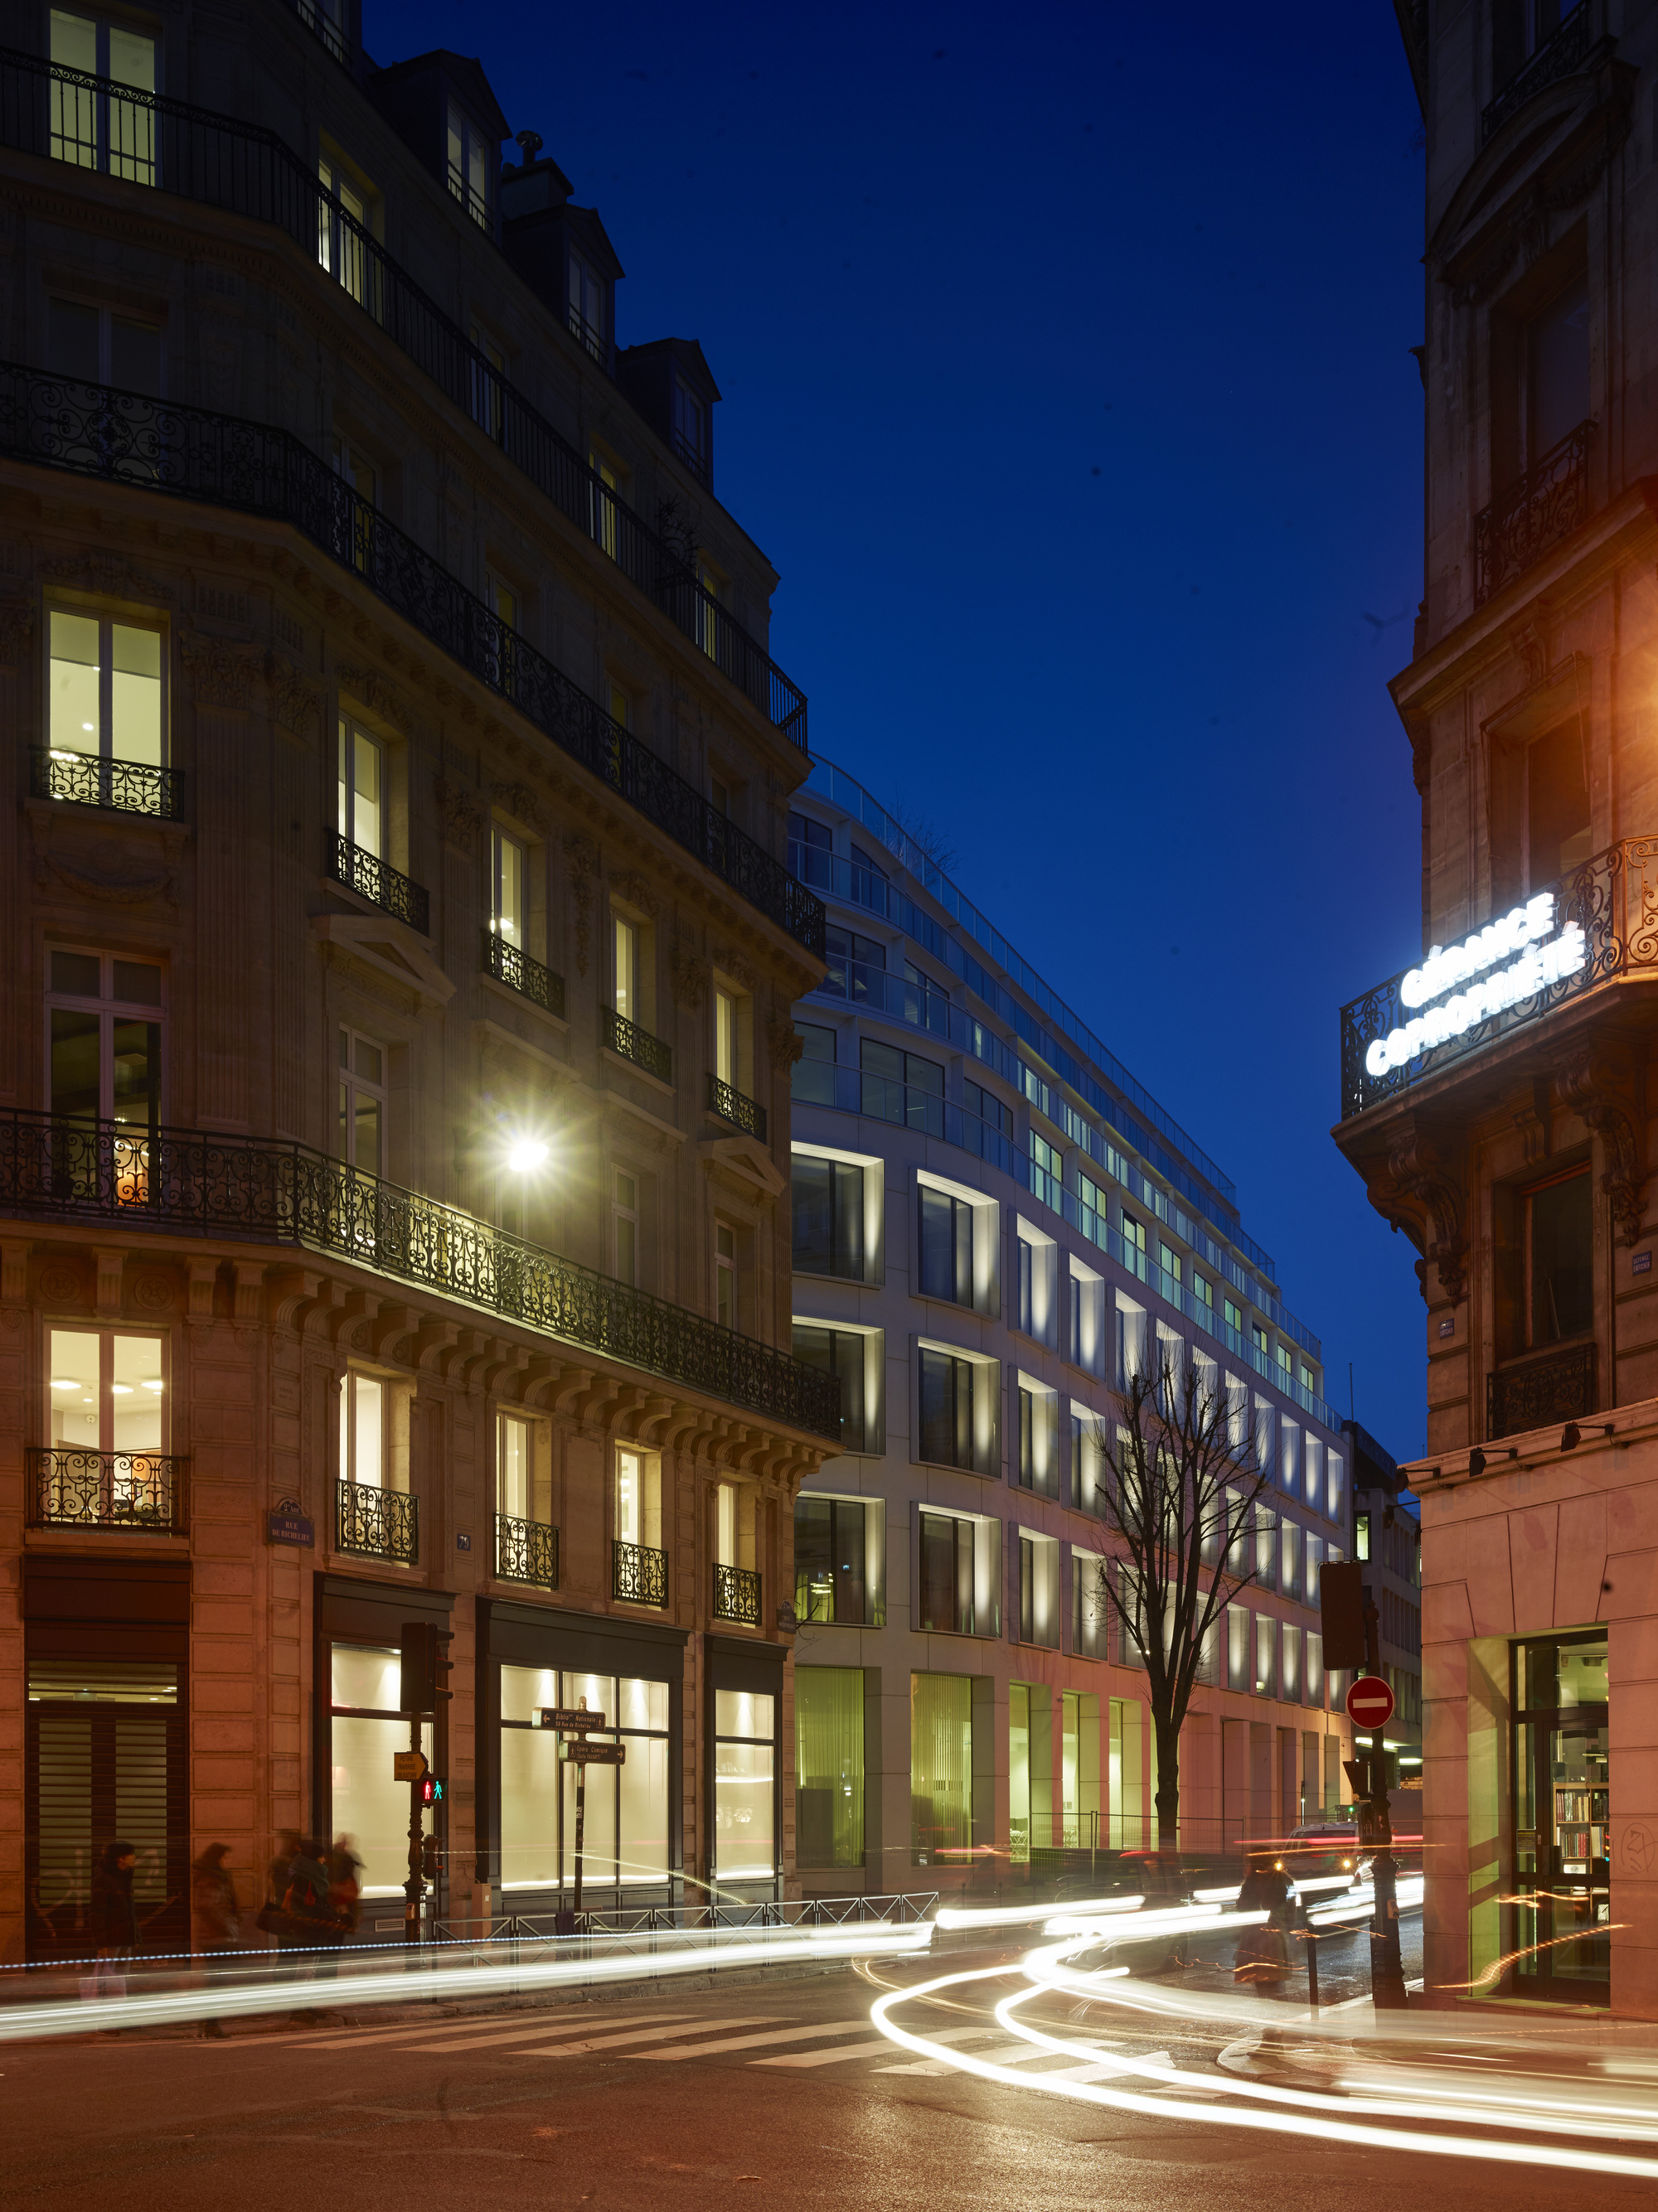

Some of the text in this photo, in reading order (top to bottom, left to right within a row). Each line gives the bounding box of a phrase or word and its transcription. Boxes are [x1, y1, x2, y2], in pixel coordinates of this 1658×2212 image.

[1365, 921, 1586, 1077] COPROPRIÉTÉ
[285, 1521, 298, 1530] RUE
[272, 1528, 312, 1542] DE RICHELIEU
[458, 1536, 469, 1549] 79
[575, 1715, 596, 1723] Nationale
[591, 1746, 608, 1755] Comique
